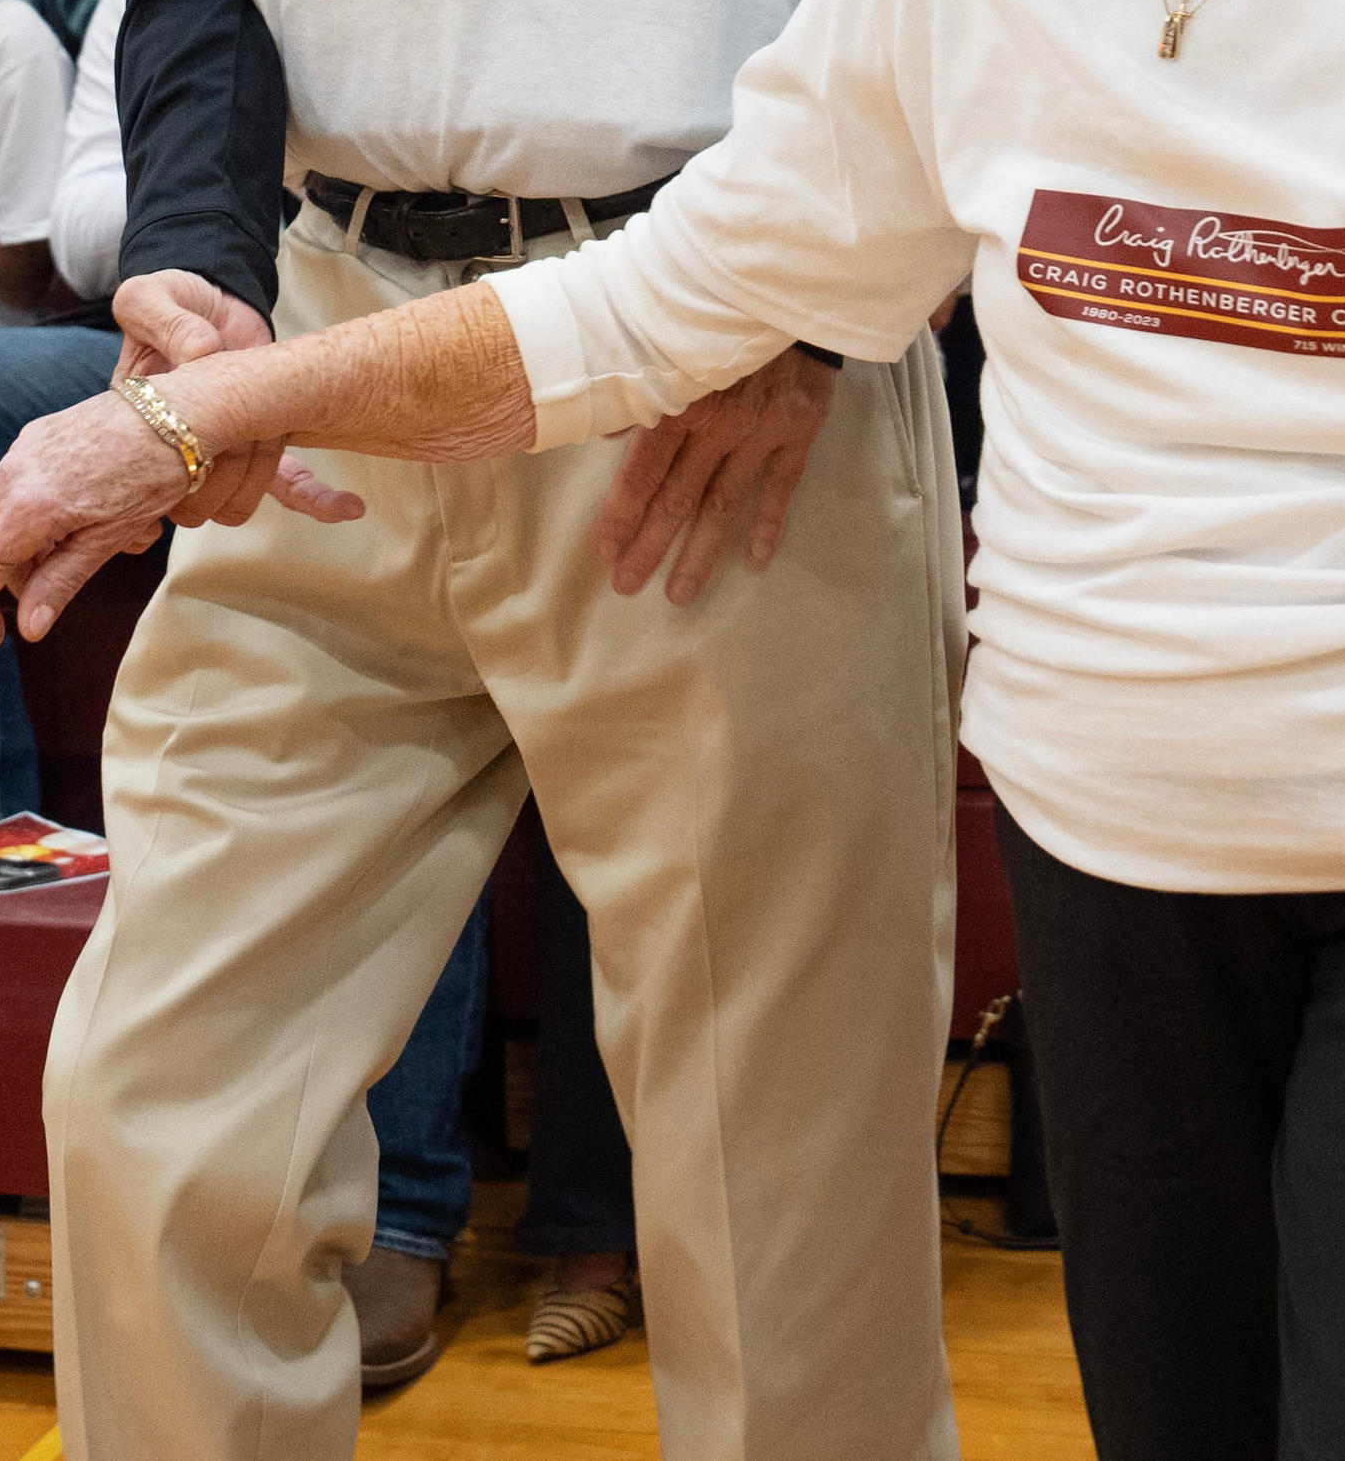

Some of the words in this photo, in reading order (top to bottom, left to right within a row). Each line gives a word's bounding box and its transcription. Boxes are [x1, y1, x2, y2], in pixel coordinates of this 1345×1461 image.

[1093, 203, 1173, 268] Craig
[1028, 262, 1108, 291] CRAIG
[1119, 278, 1317, 325] ROTHENBERGER
[1081, 305, 1161, 328] 1980-2023
[1293, 339, 1318, 352] 715
